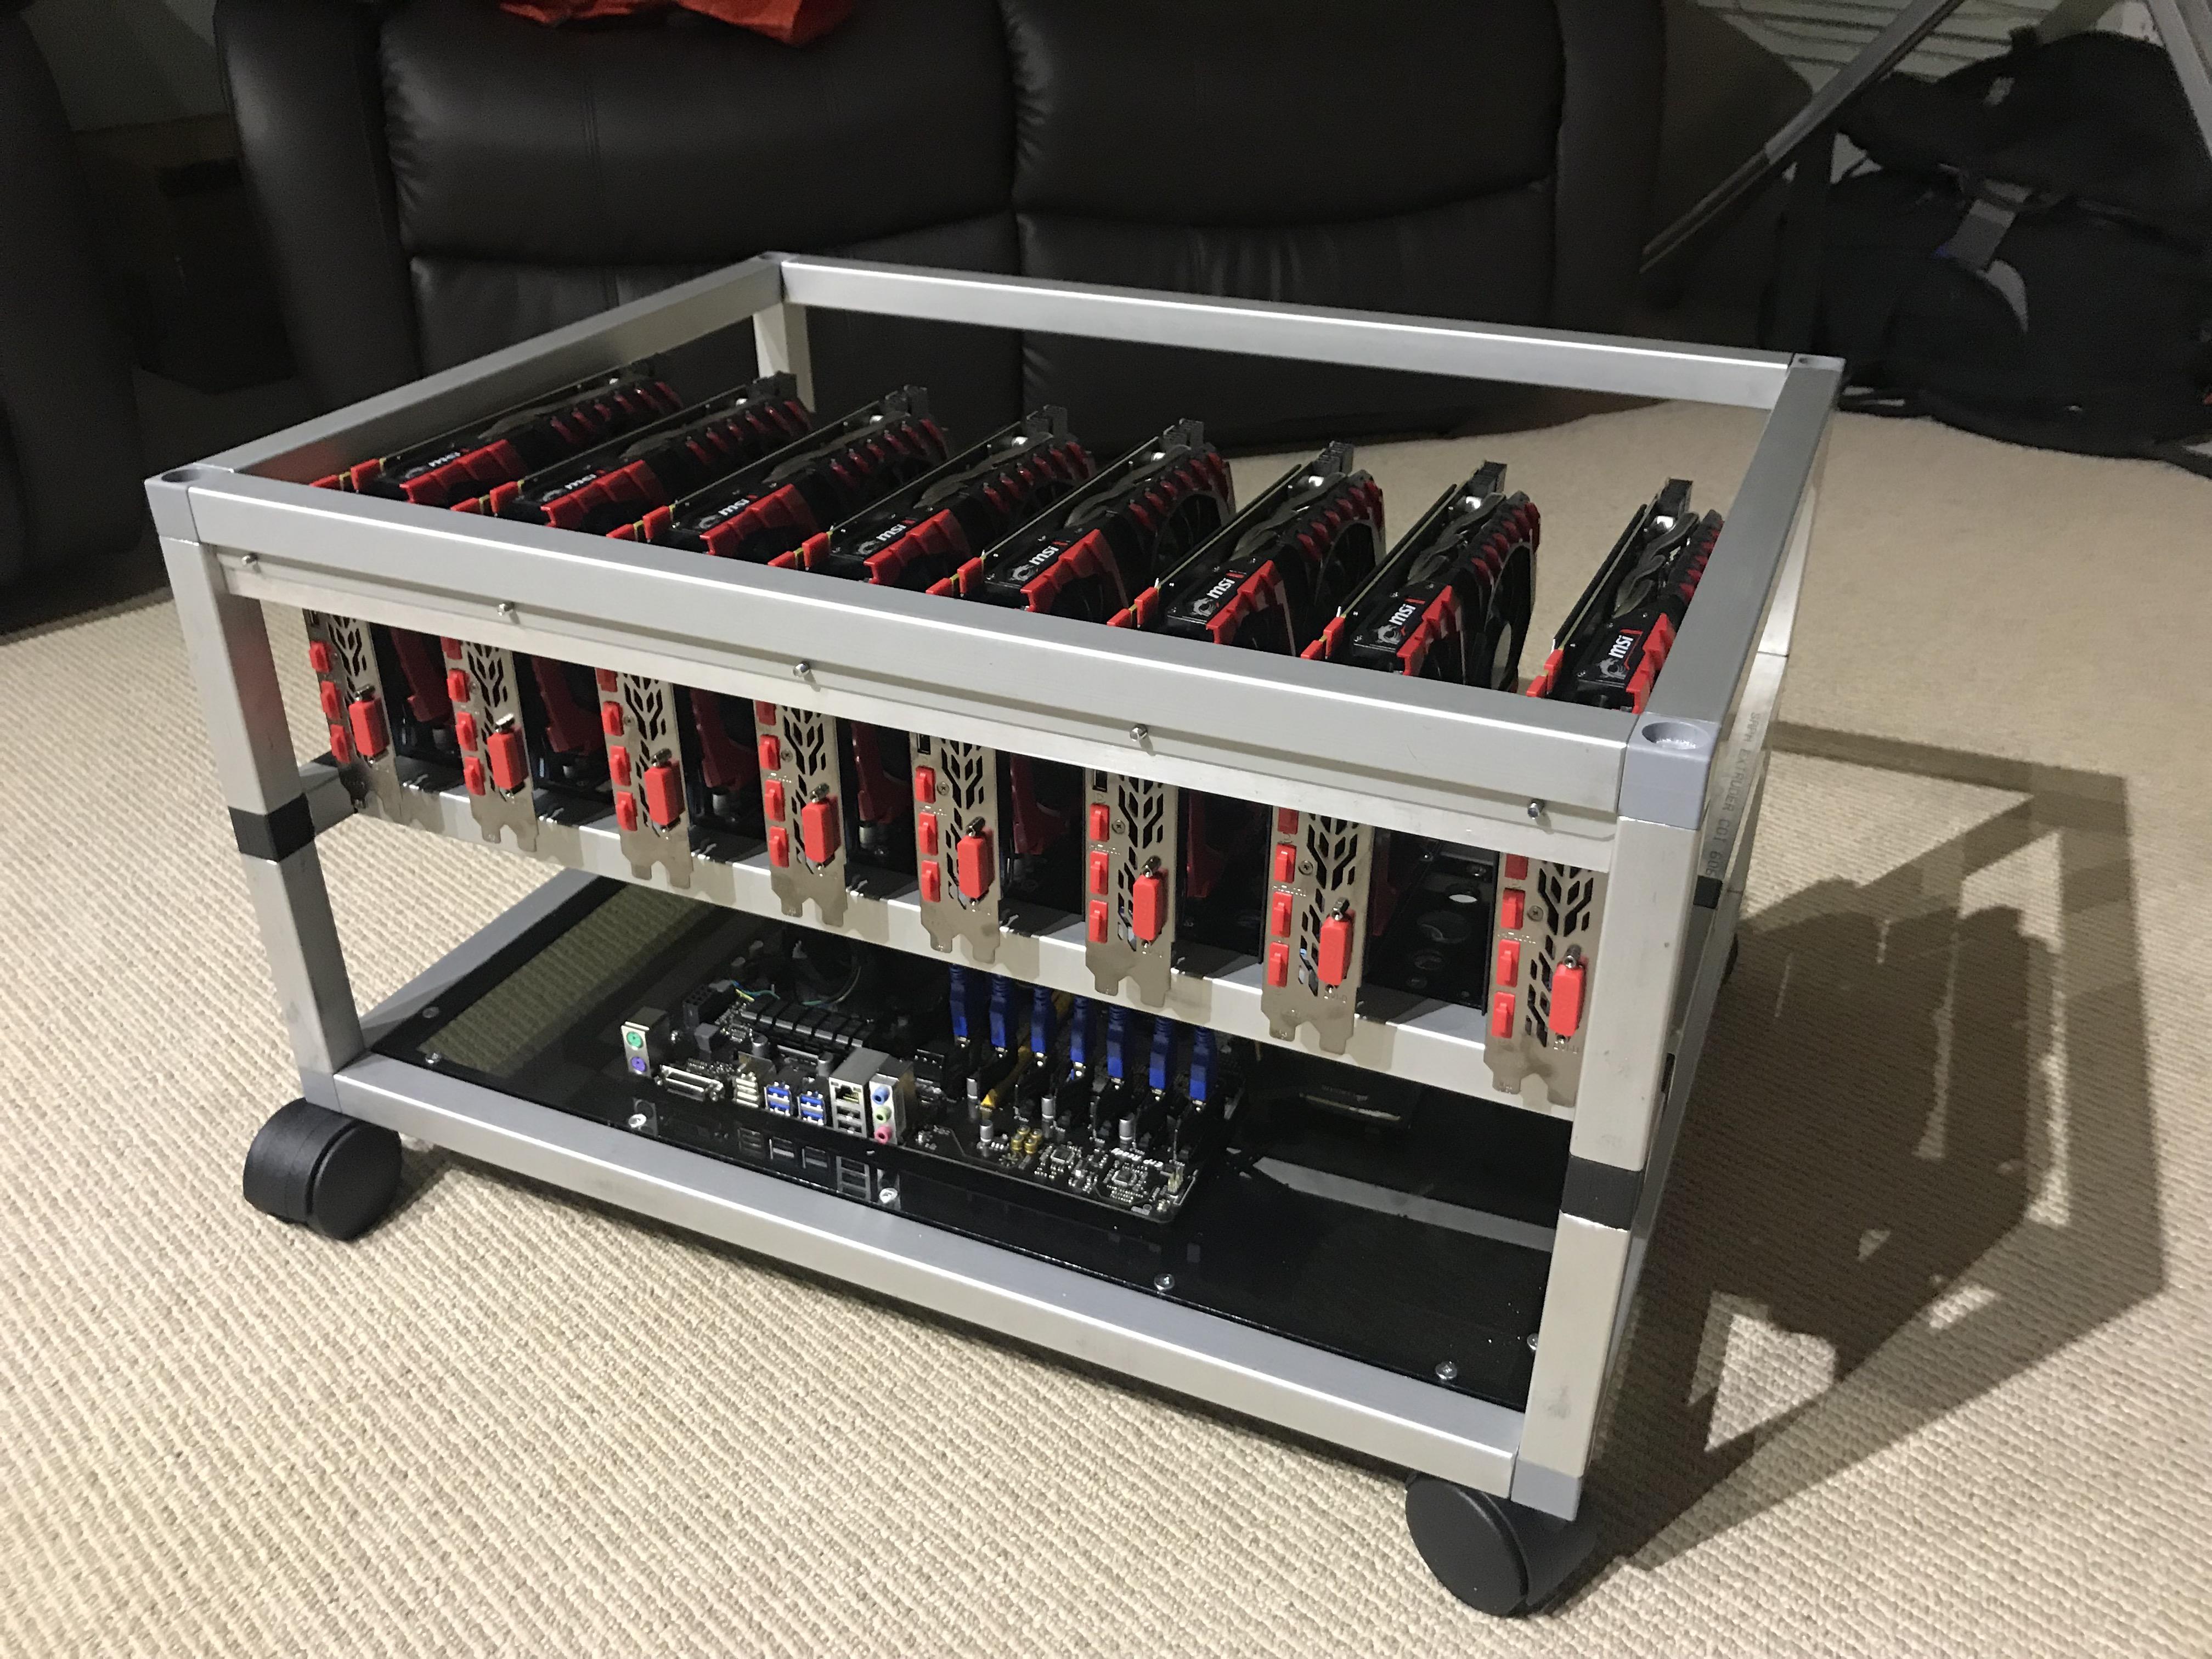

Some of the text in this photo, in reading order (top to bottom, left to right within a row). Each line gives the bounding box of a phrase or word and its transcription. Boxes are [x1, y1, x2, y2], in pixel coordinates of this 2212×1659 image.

[718, 499, 750, 516] msi
[876, 524, 907, 541] msi
[1029, 545, 1059, 565] msi
[1206, 578, 1235, 599] msi
[1389, 603, 1416, 625] msi
[1608, 635, 1633, 658] msi
[1722, 748, 1752, 812] EXTRUDER
